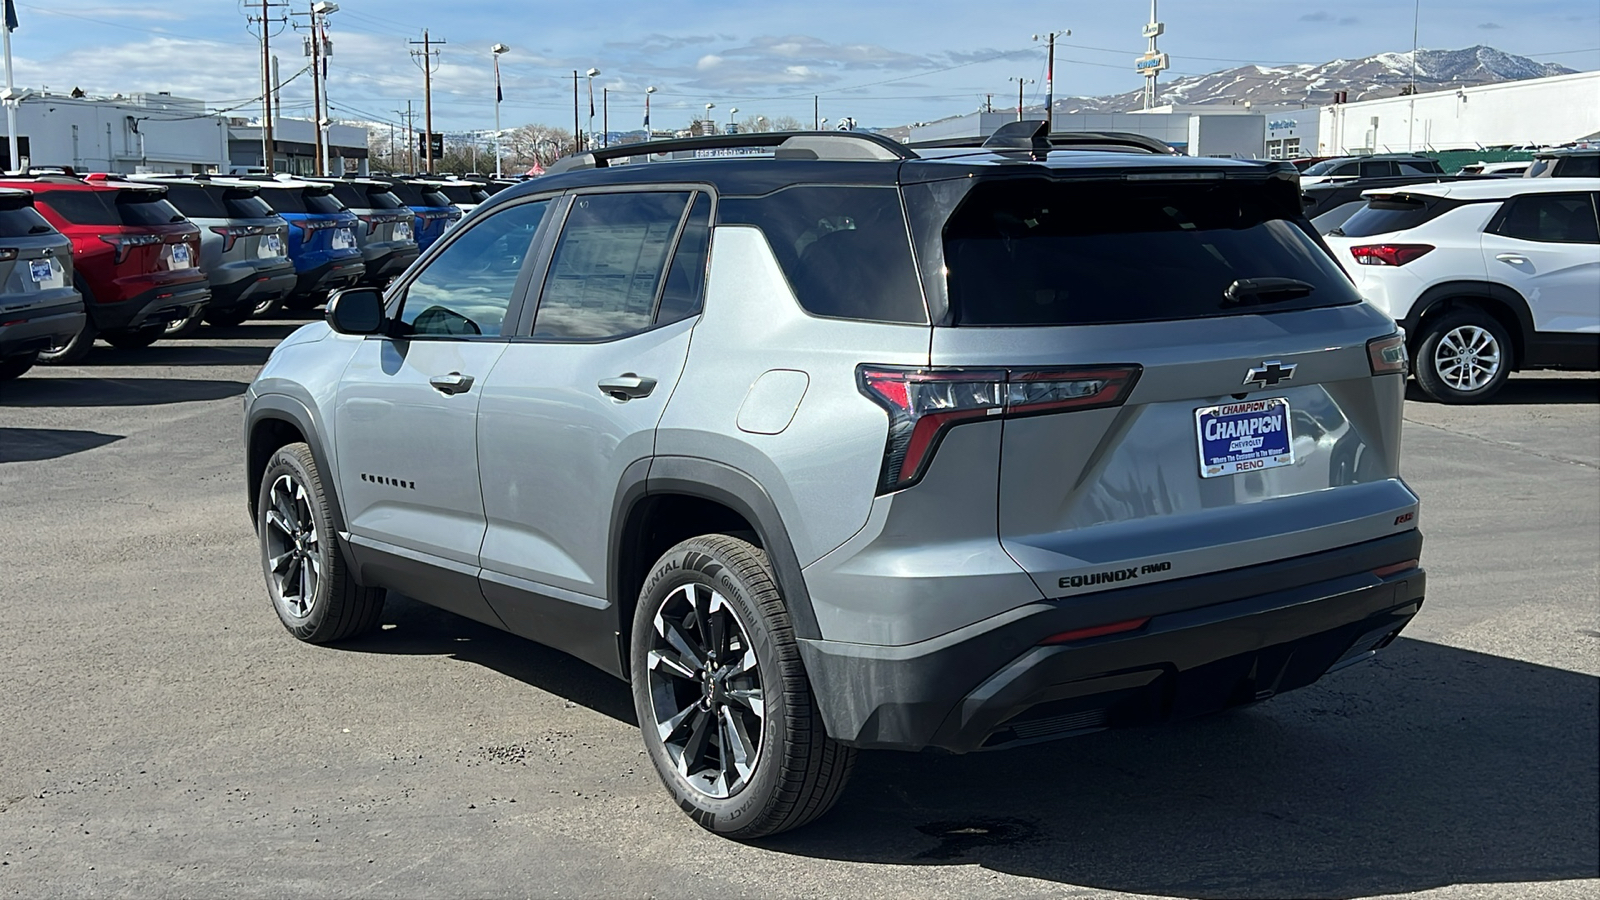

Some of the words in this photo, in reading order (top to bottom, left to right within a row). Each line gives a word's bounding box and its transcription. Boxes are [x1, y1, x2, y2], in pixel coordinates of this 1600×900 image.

[1222, 402, 1265, 415] CHAMPION
[1205, 415, 1282, 441] CHAMPION
[1231, 438, 1262, 449] CHEVROLET
[1236, 460, 1264, 471] RENO
[360, 473, 416, 490] EQUINOX
[1058, 567, 1138, 588] EQUINOX
[1141, 561, 1171, 575] AWD
[720, 574, 758, 628] Continental
